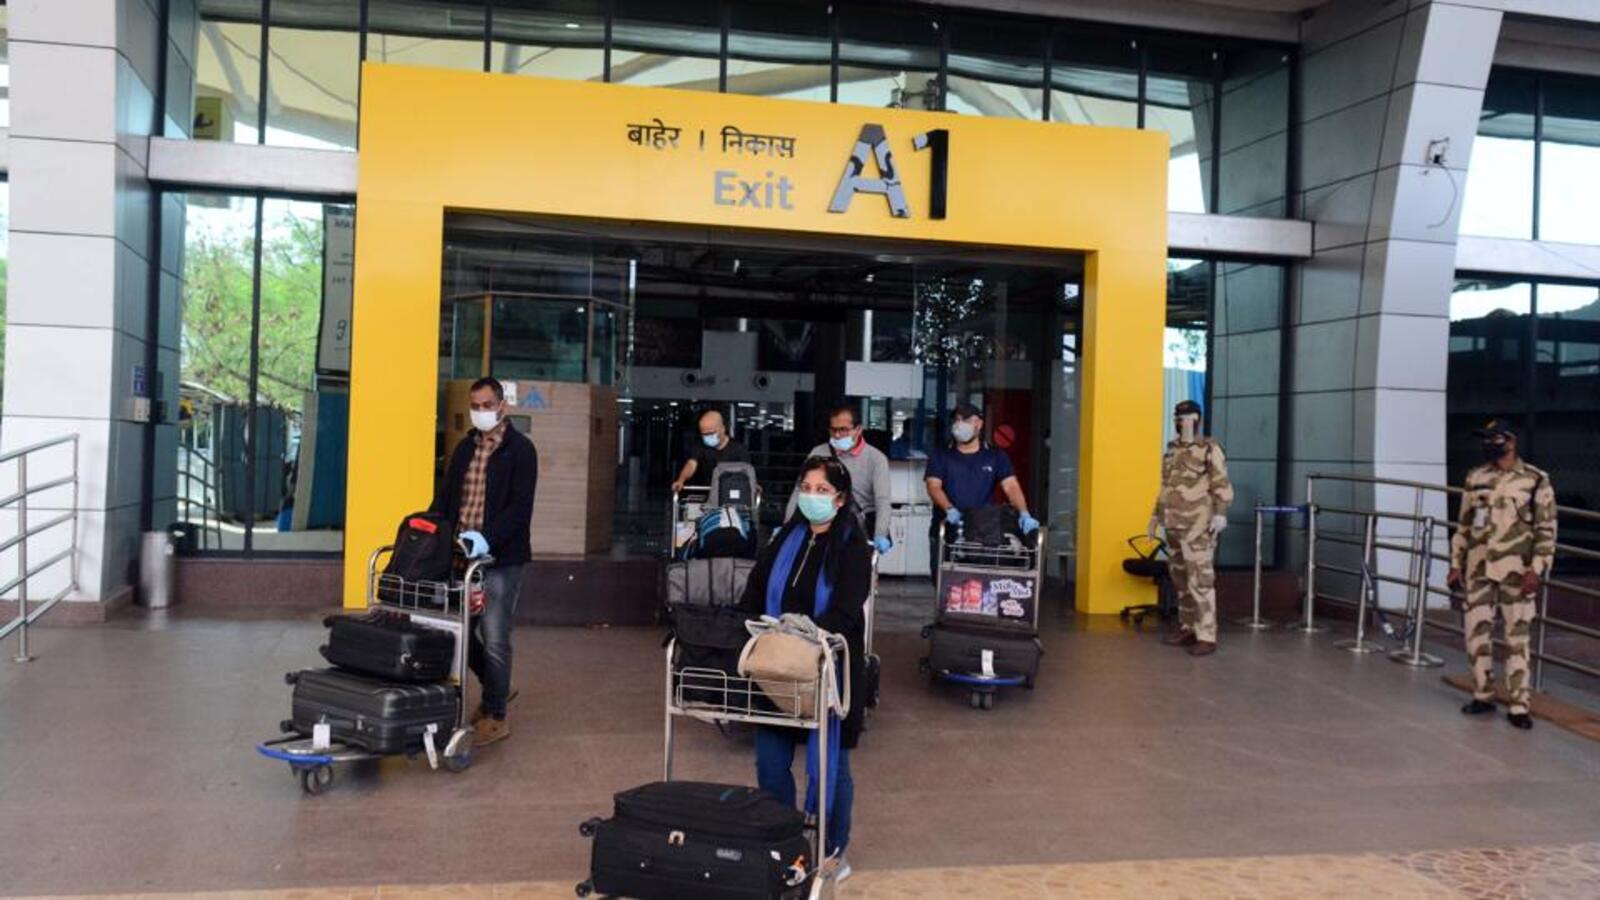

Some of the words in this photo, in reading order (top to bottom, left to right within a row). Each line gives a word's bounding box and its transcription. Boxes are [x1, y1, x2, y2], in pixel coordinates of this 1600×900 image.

[626, 118, 682, 149] बाहेर
[720, 125, 796, 158] निकास
[714, 170, 795, 210] Exit
[827, 123, 949, 220] A1
